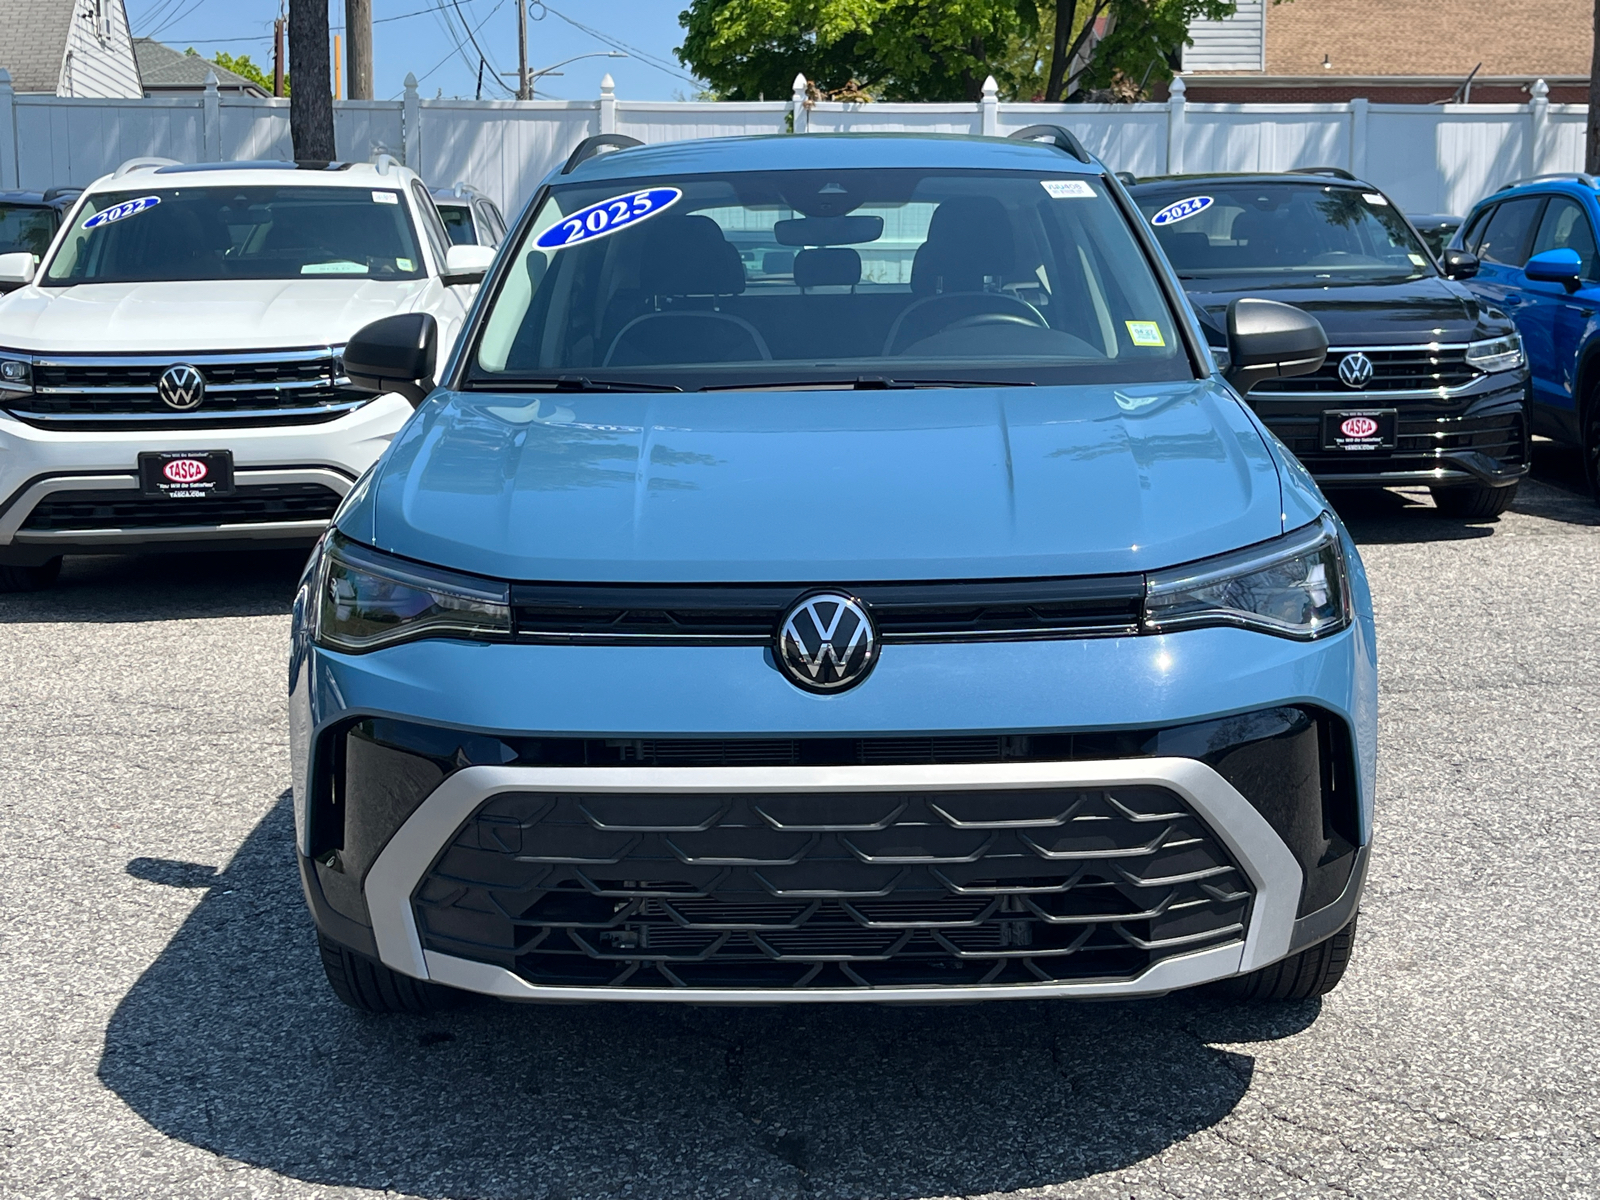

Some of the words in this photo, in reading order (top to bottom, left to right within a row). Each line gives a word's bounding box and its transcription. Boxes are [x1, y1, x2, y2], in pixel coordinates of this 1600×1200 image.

[96, 199, 146, 227] 2022
[562, 191, 653, 244] 2025
[1161, 198, 1203, 223] 2024
[161, 366, 202, 407] VW
[1345, 419, 1373, 434] TASCA
[169, 461, 202, 479] TASCA
[782, 595, 871, 685] VW
